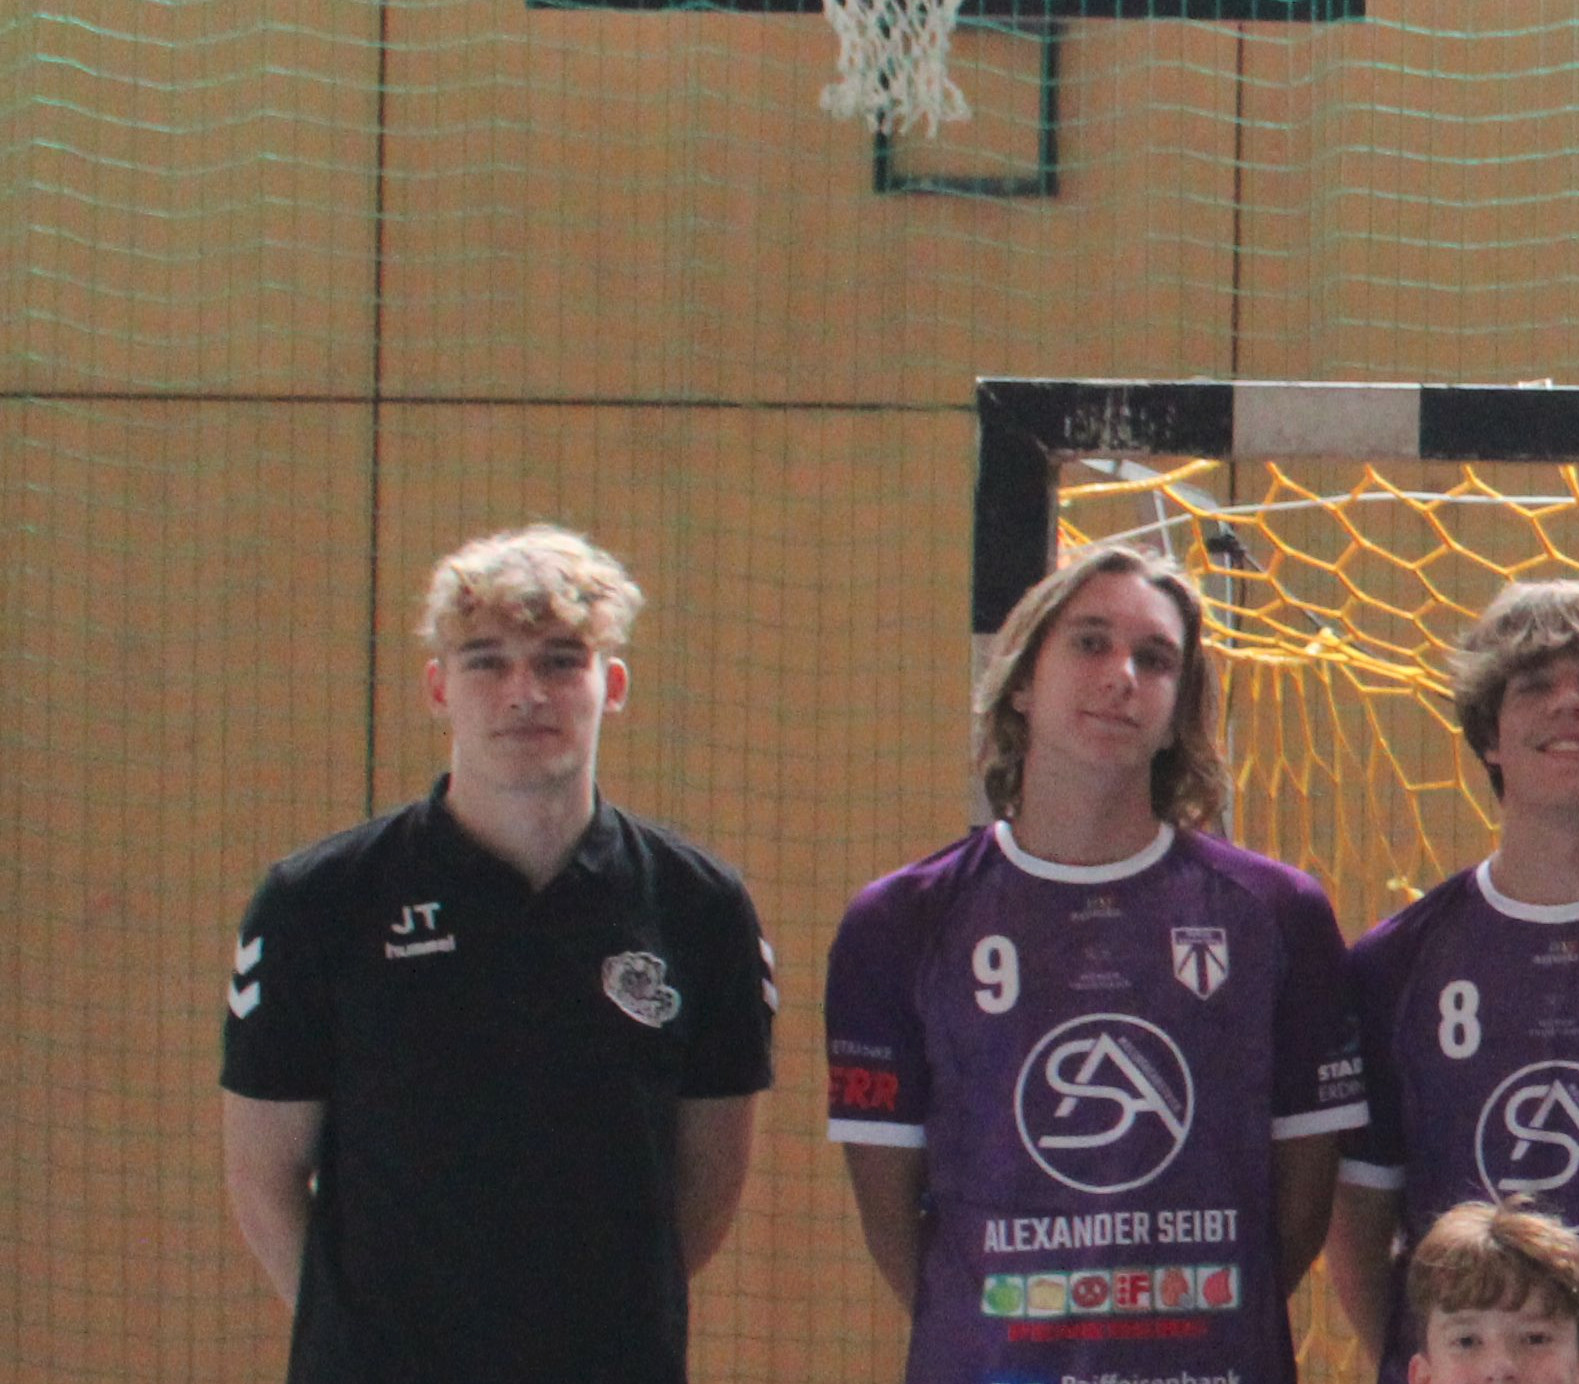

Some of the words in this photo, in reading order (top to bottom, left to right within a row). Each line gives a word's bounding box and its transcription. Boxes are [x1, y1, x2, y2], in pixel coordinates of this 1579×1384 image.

[391, 902, 441, 934] JT
[972, 935, 1019, 1014] 9
[1438, 980, 1481, 1059] 8
[984, 1213, 1151, 1254] ALEXANDER
[1158, 1209, 1239, 1243] SEIBT
